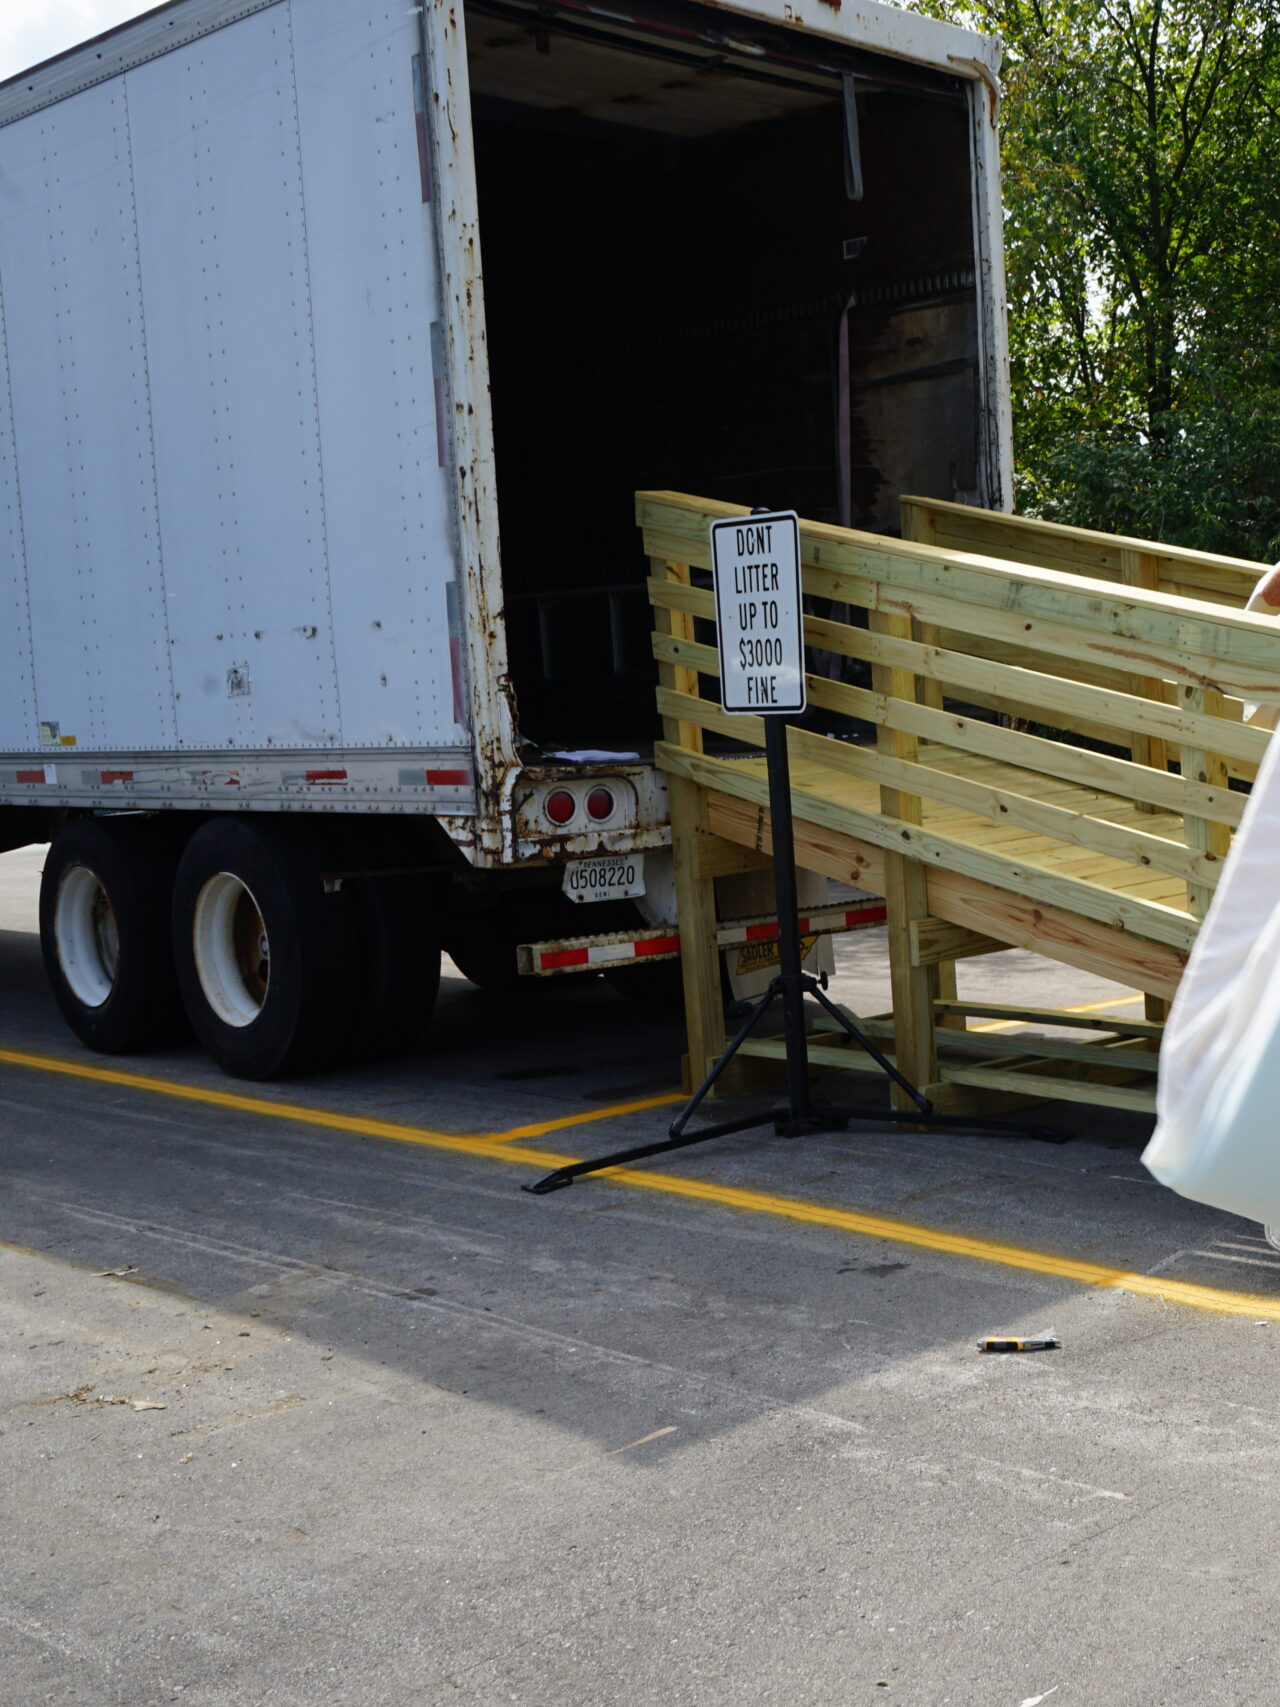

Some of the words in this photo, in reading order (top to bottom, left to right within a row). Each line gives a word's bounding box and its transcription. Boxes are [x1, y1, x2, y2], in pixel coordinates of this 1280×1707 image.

[736, 525, 772, 556] DONT
[734, 562, 779, 594] LITTER
[739, 602, 757, 631] UP
[762, 600, 778, 629] TO
[739, 637, 783, 670] $3000
[747, 676, 778, 704] FINE
[570, 865, 635, 890] U508220
[583, 858, 625, 869] TENNESSEE
[742, 943, 774, 962] SADLER
